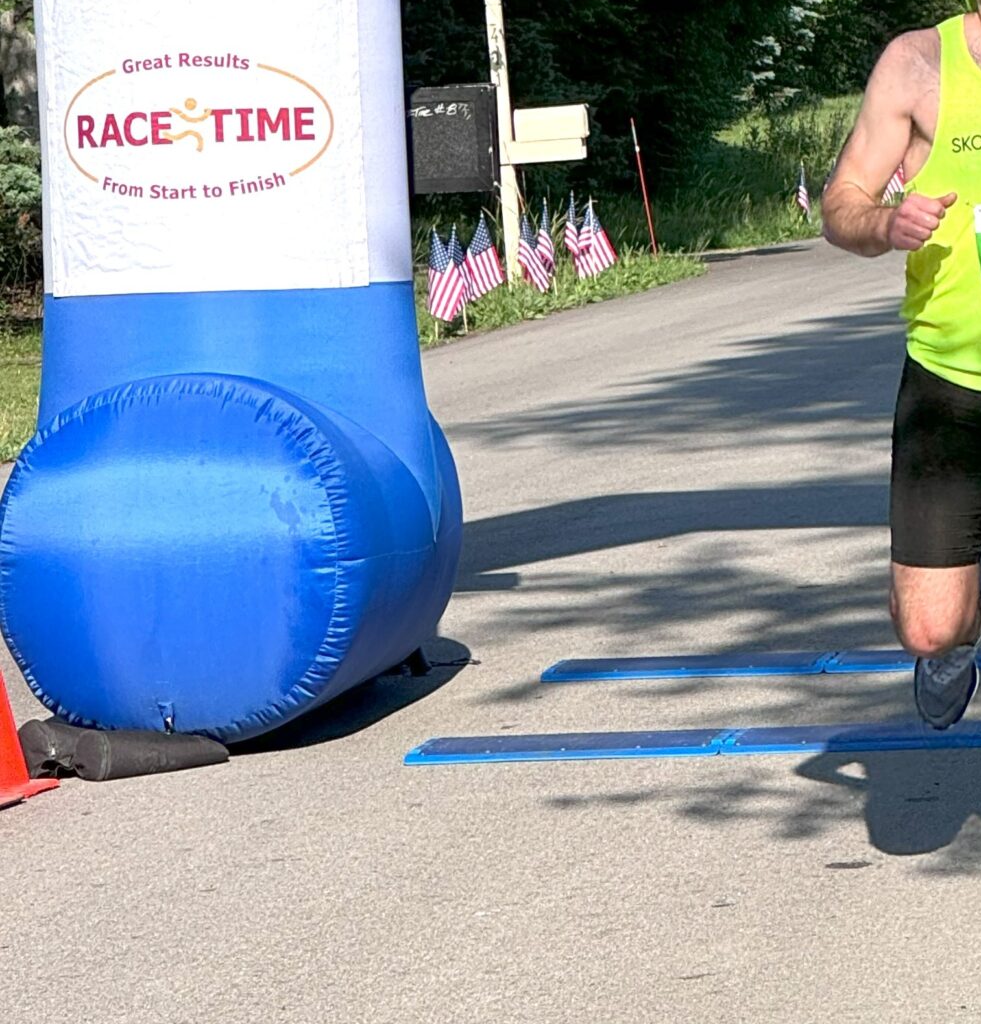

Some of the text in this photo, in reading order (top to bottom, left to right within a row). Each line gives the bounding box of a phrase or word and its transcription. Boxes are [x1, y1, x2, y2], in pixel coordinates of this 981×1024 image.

[122, 53, 250, 74] Great Results
[77, 107, 315, 148] RACE TIME
[102, 172, 286, 200] From Start to Finish
